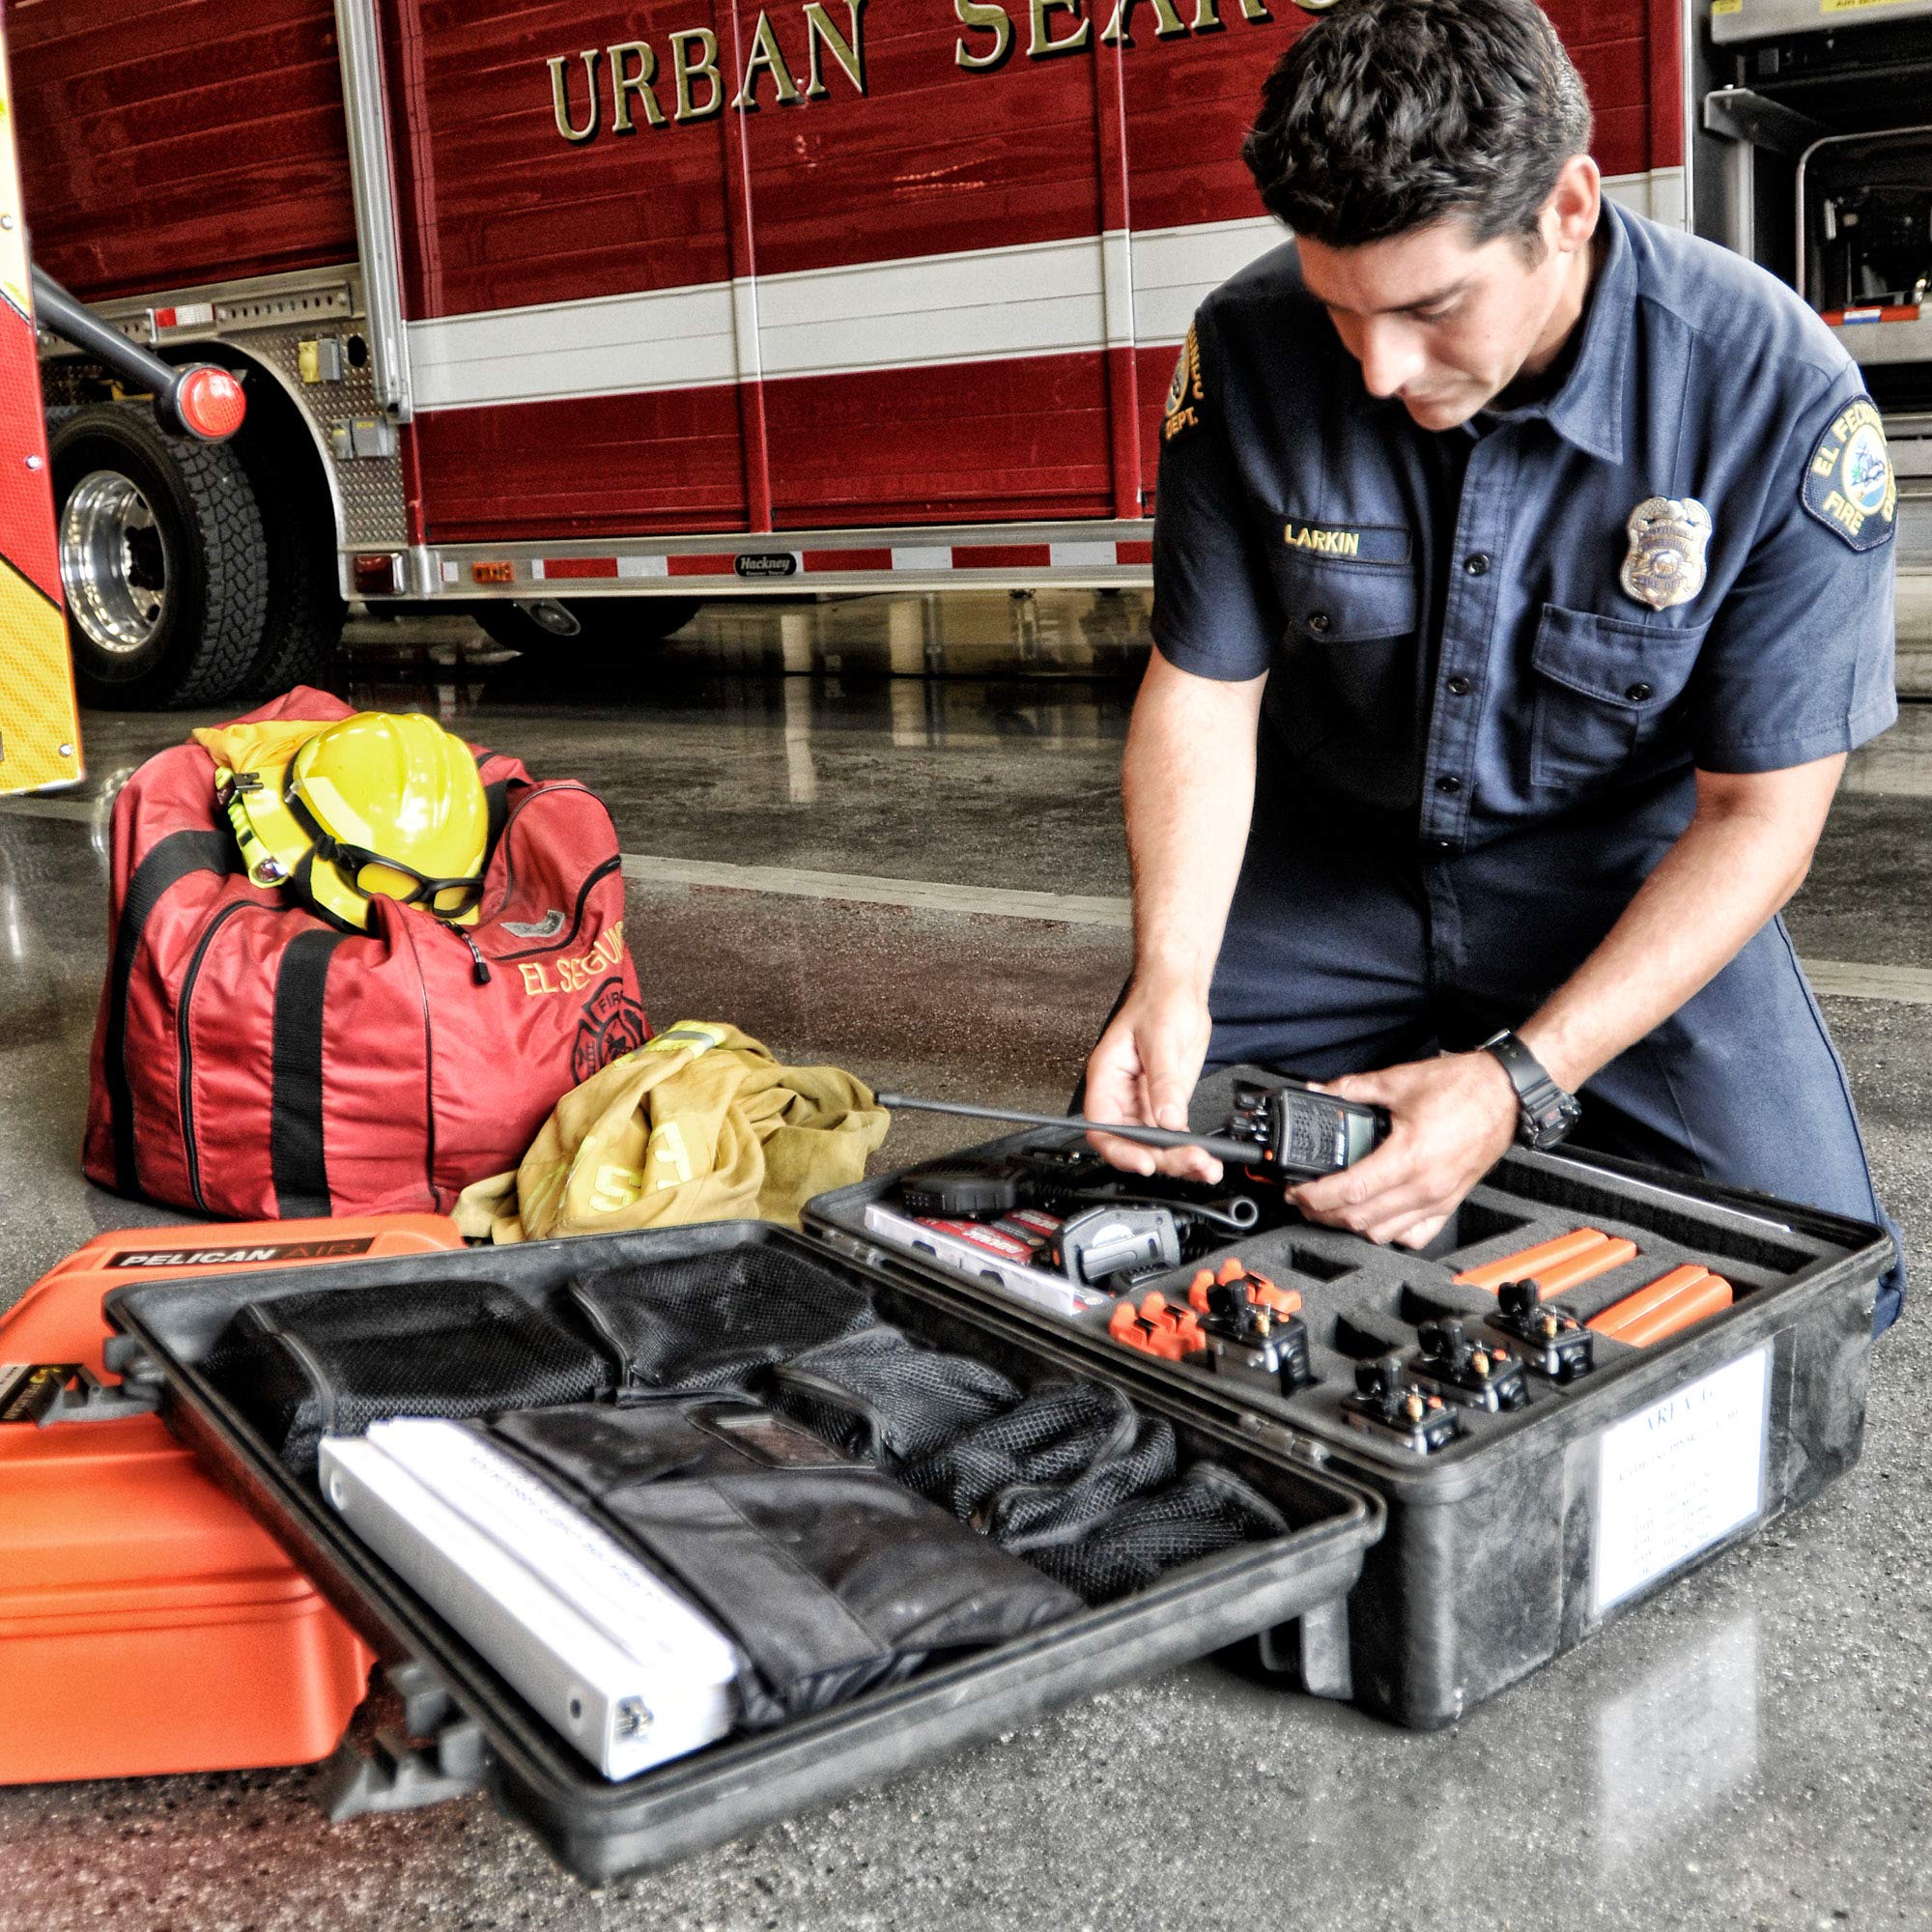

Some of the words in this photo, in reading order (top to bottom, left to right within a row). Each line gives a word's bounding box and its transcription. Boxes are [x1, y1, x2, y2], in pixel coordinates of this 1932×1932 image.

[547, 0, 867, 142] URBAN
[1166, 407, 1199, 440] DEPT.
[1811, 445, 1840, 477] EL
[1823, 490, 1865, 538] FIRE
[1284, 524, 1360, 556] LARKIN
[740, 556, 790, 571] Hackney
[518, 962, 557, 996] EL
[598, 989, 624, 1014] FIR
[119, 1249, 277, 1266] PELICAN
[282, 1243, 355, 1259] AIR
